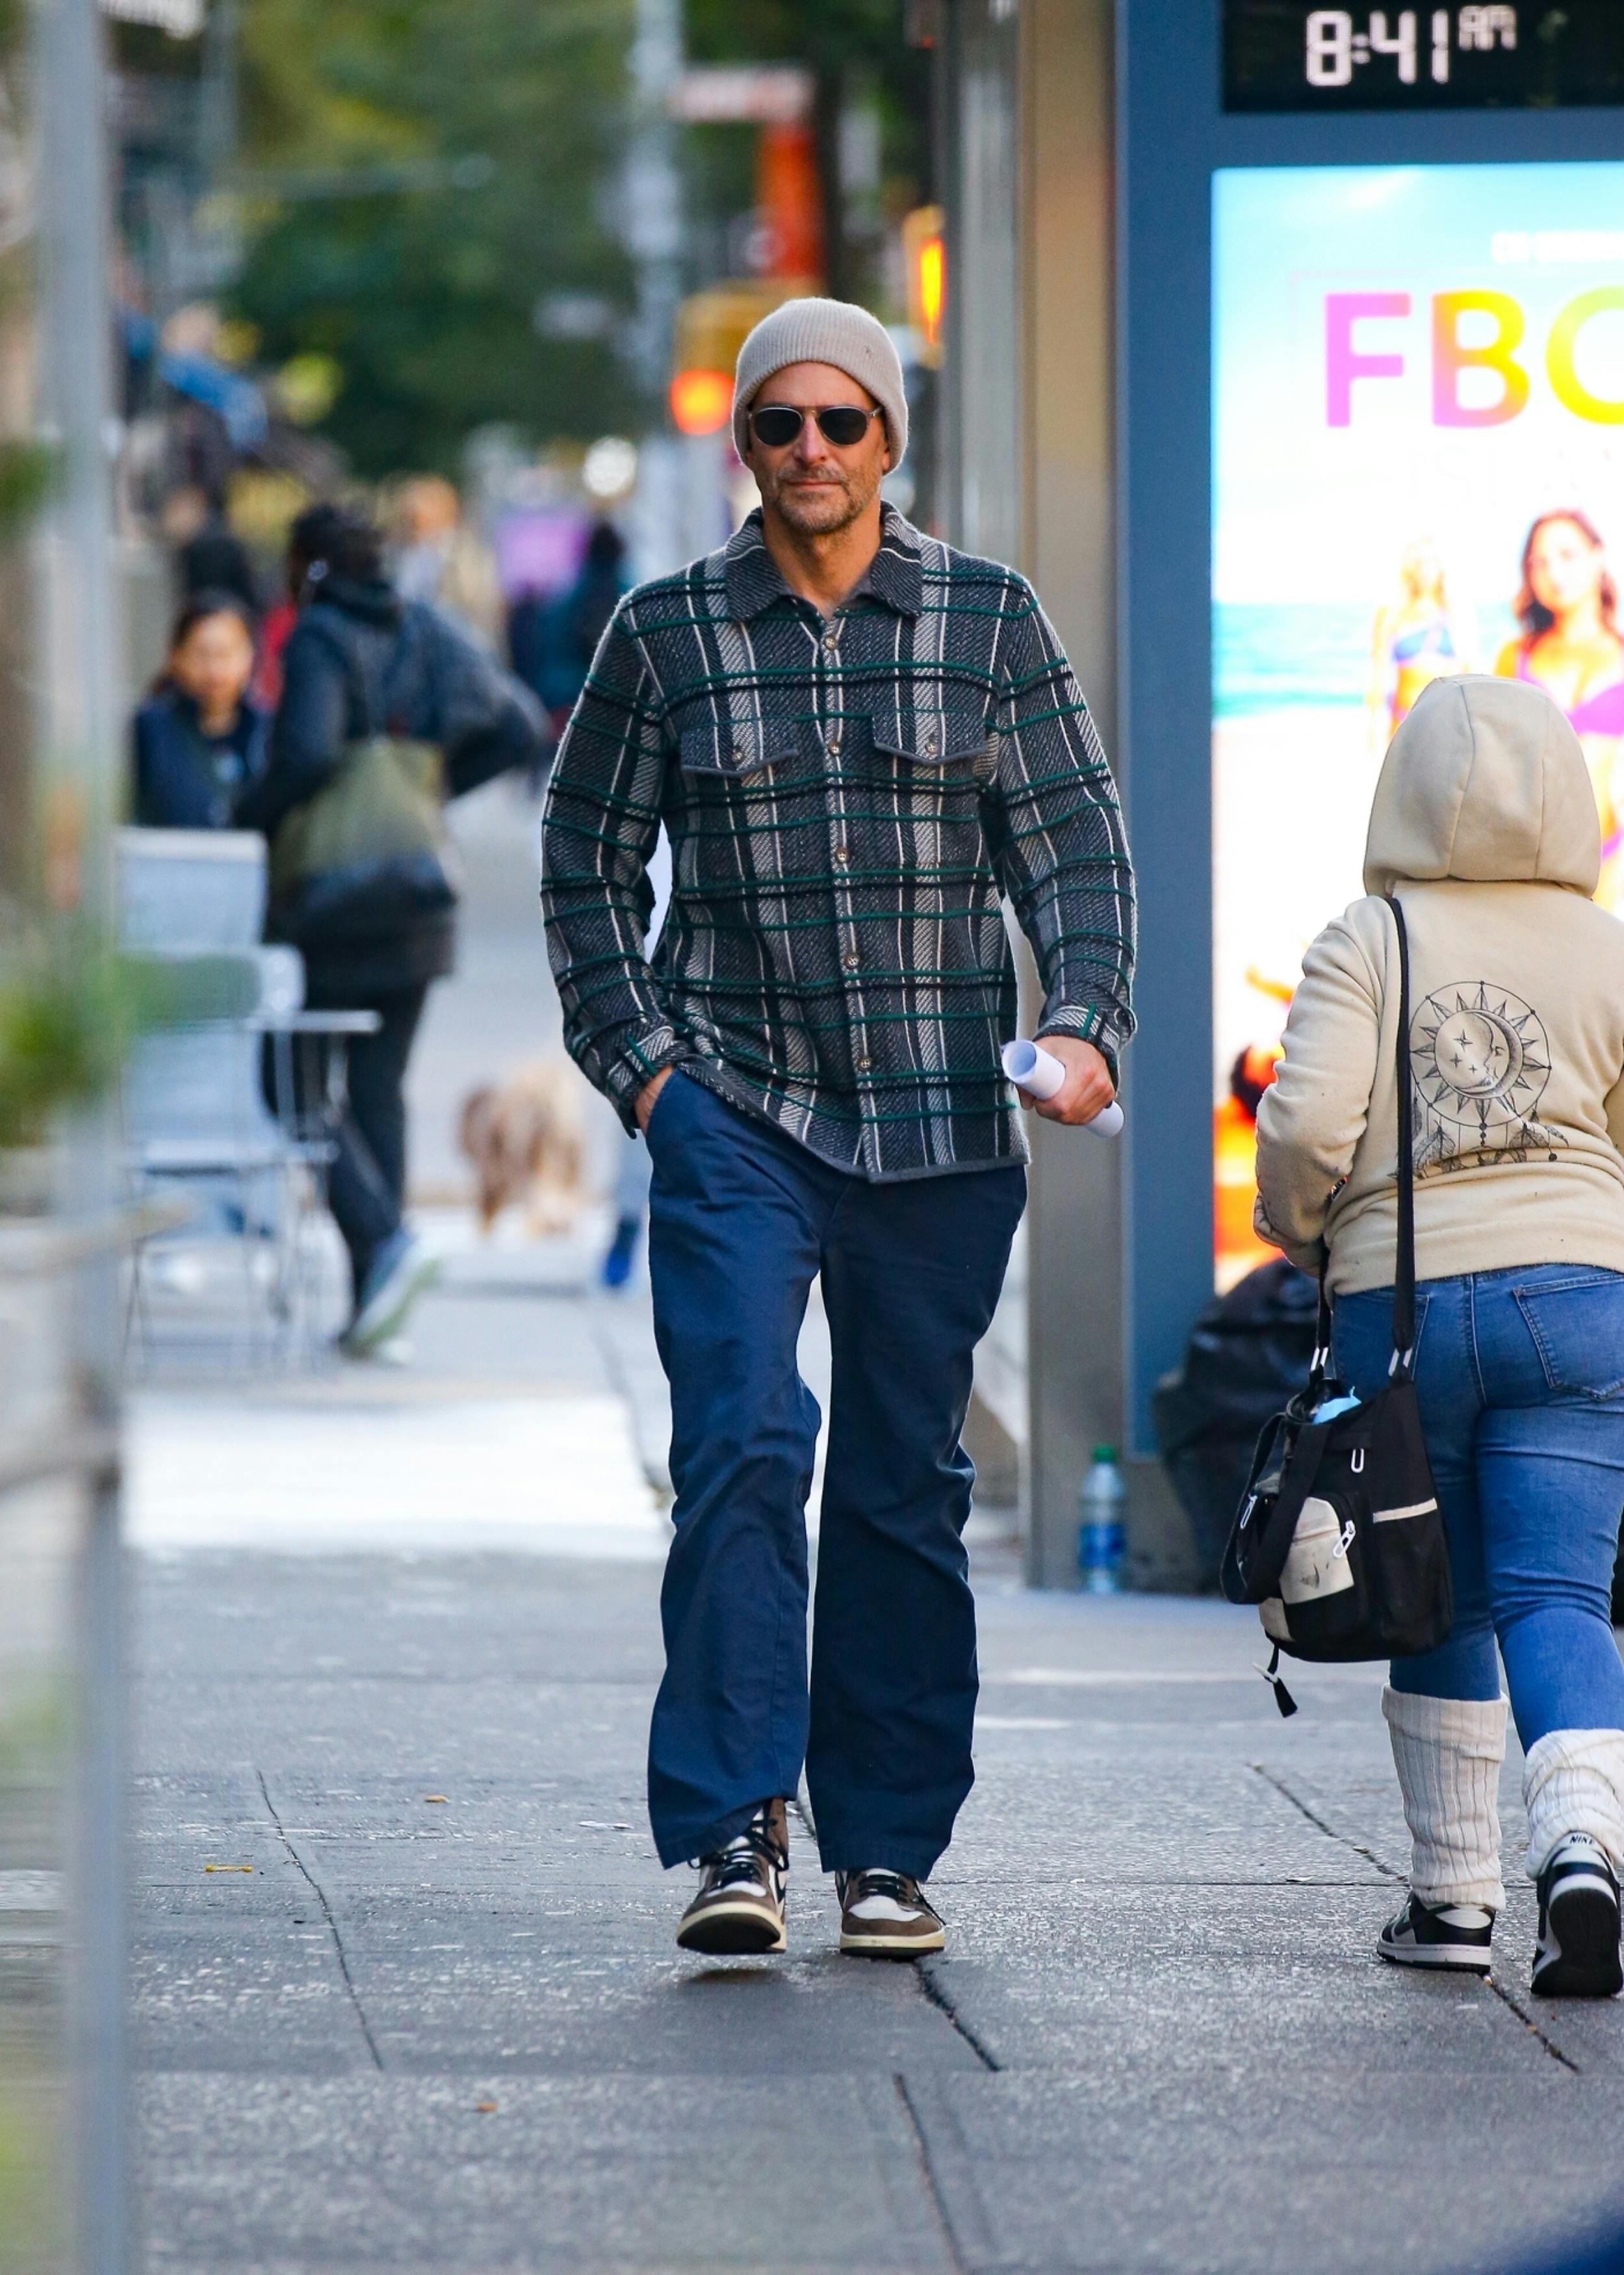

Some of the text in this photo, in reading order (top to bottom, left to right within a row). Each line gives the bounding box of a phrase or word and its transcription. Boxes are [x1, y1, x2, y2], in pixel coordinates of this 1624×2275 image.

[1306, 5, 1516, 86] 8:41 AM
[1569, 1835, 1595, 1845] NIKE
